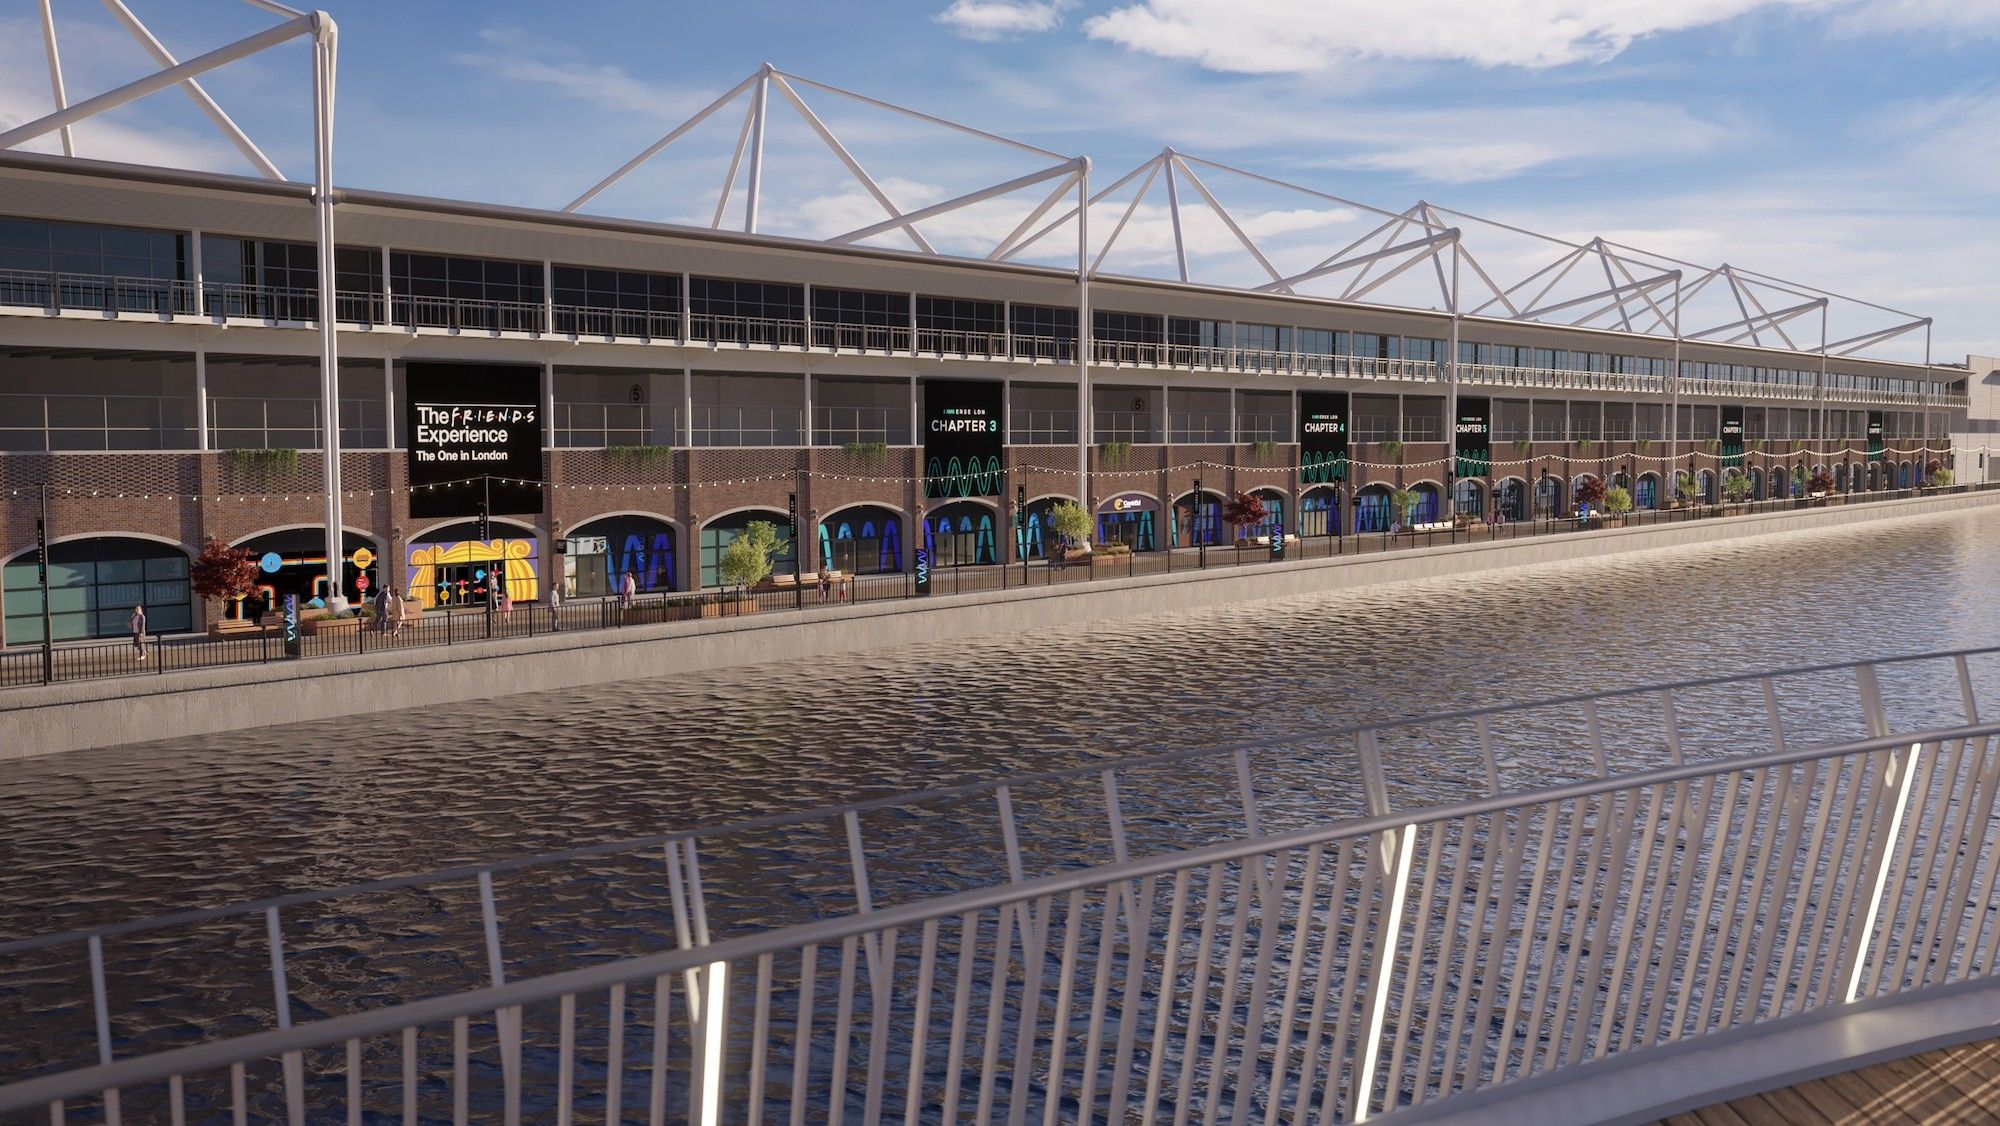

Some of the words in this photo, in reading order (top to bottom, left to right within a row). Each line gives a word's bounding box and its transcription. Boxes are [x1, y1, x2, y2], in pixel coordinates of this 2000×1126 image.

[417, 406, 450, 424] The
[931, 419, 987, 432] CHAPTER
[989, 420, 997, 432] 3
[1304, 422, 1339, 433] CHAPTER
[1339, 423, 1345, 433] 4
[1456, 424, 1482, 433] CHAPTER
[1482, 424, 1488, 433] 5
[417, 425, 508, 447] Experience
[416, 450, 435, 461] The
[437, 450, 458, 461] One
[460, 449, 469, 461] in
[471, 449, 508, 461] London
